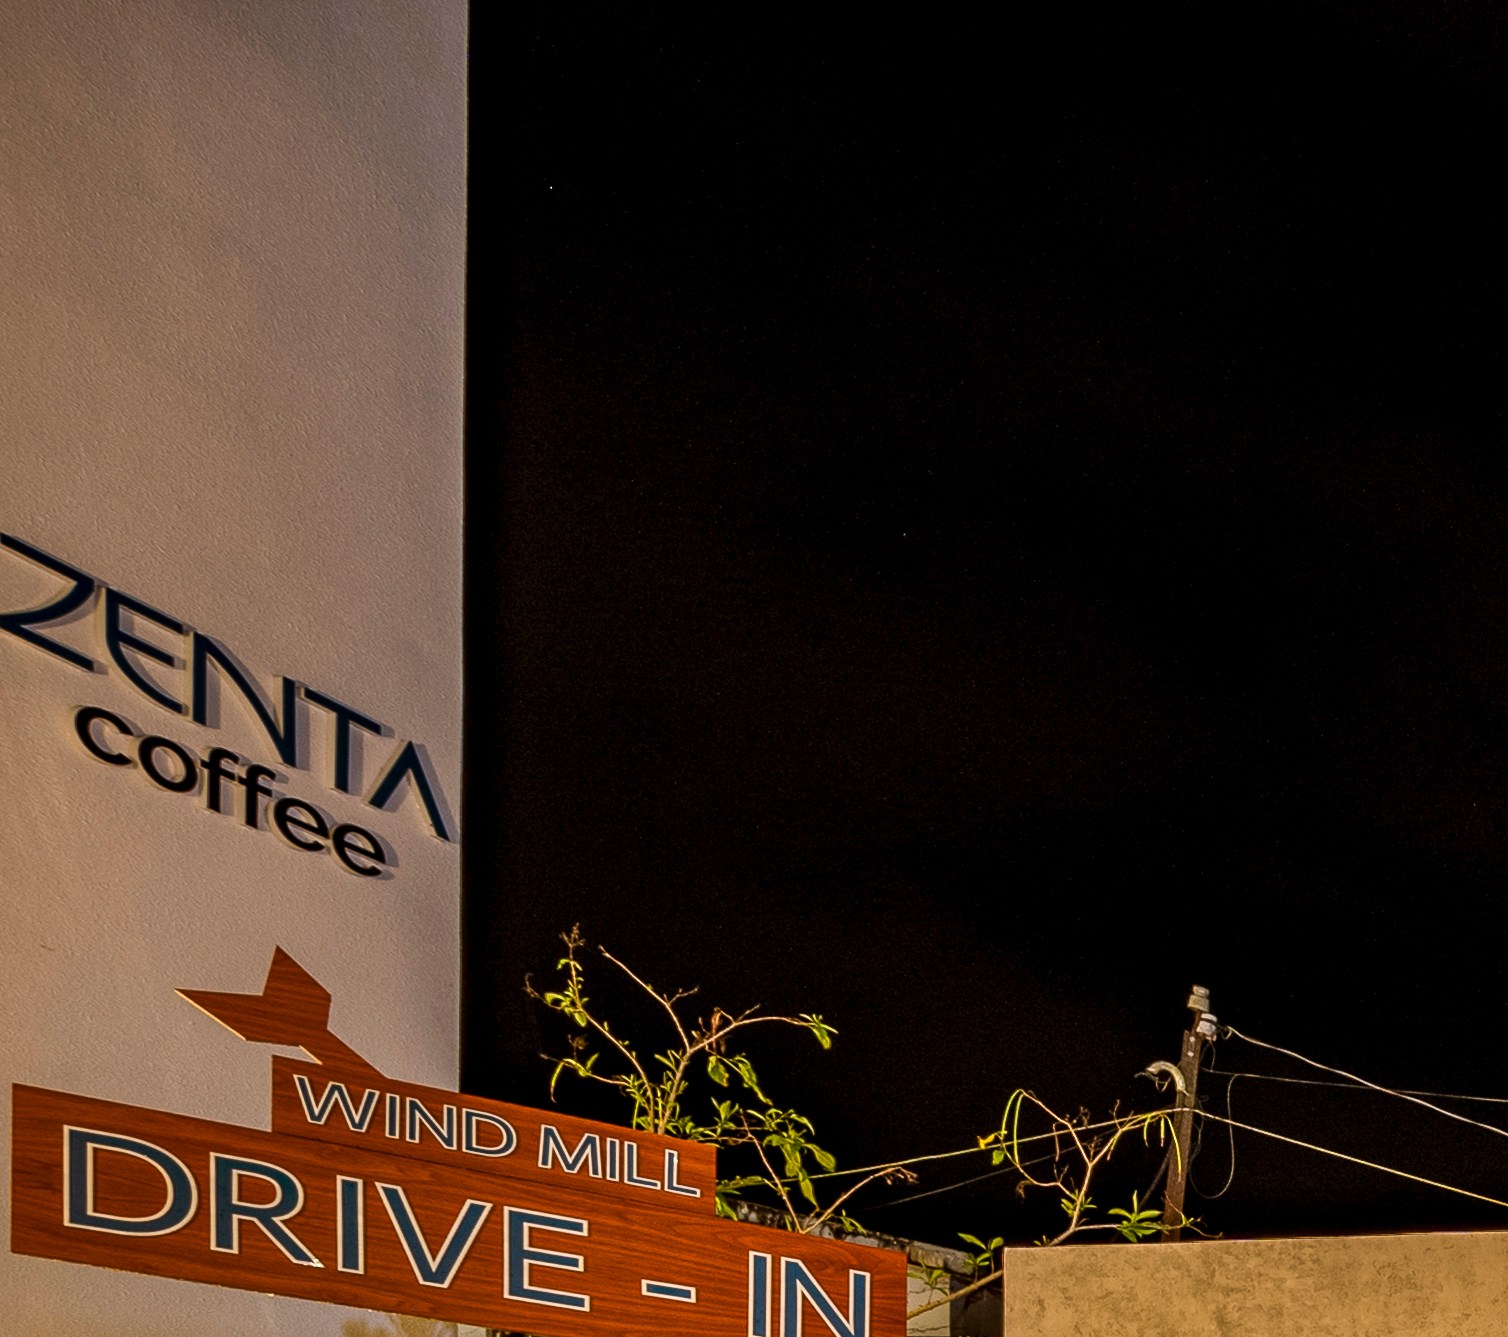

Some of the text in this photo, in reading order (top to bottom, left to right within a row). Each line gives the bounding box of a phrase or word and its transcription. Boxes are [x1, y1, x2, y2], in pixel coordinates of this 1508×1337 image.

[0, 534, 450, 841] ZENTA
[73, 704, 387, 878] coffee
[62, 1123, 592, 1312] DRIVE
[292, 1073, 702, 1199] WIND MILL
